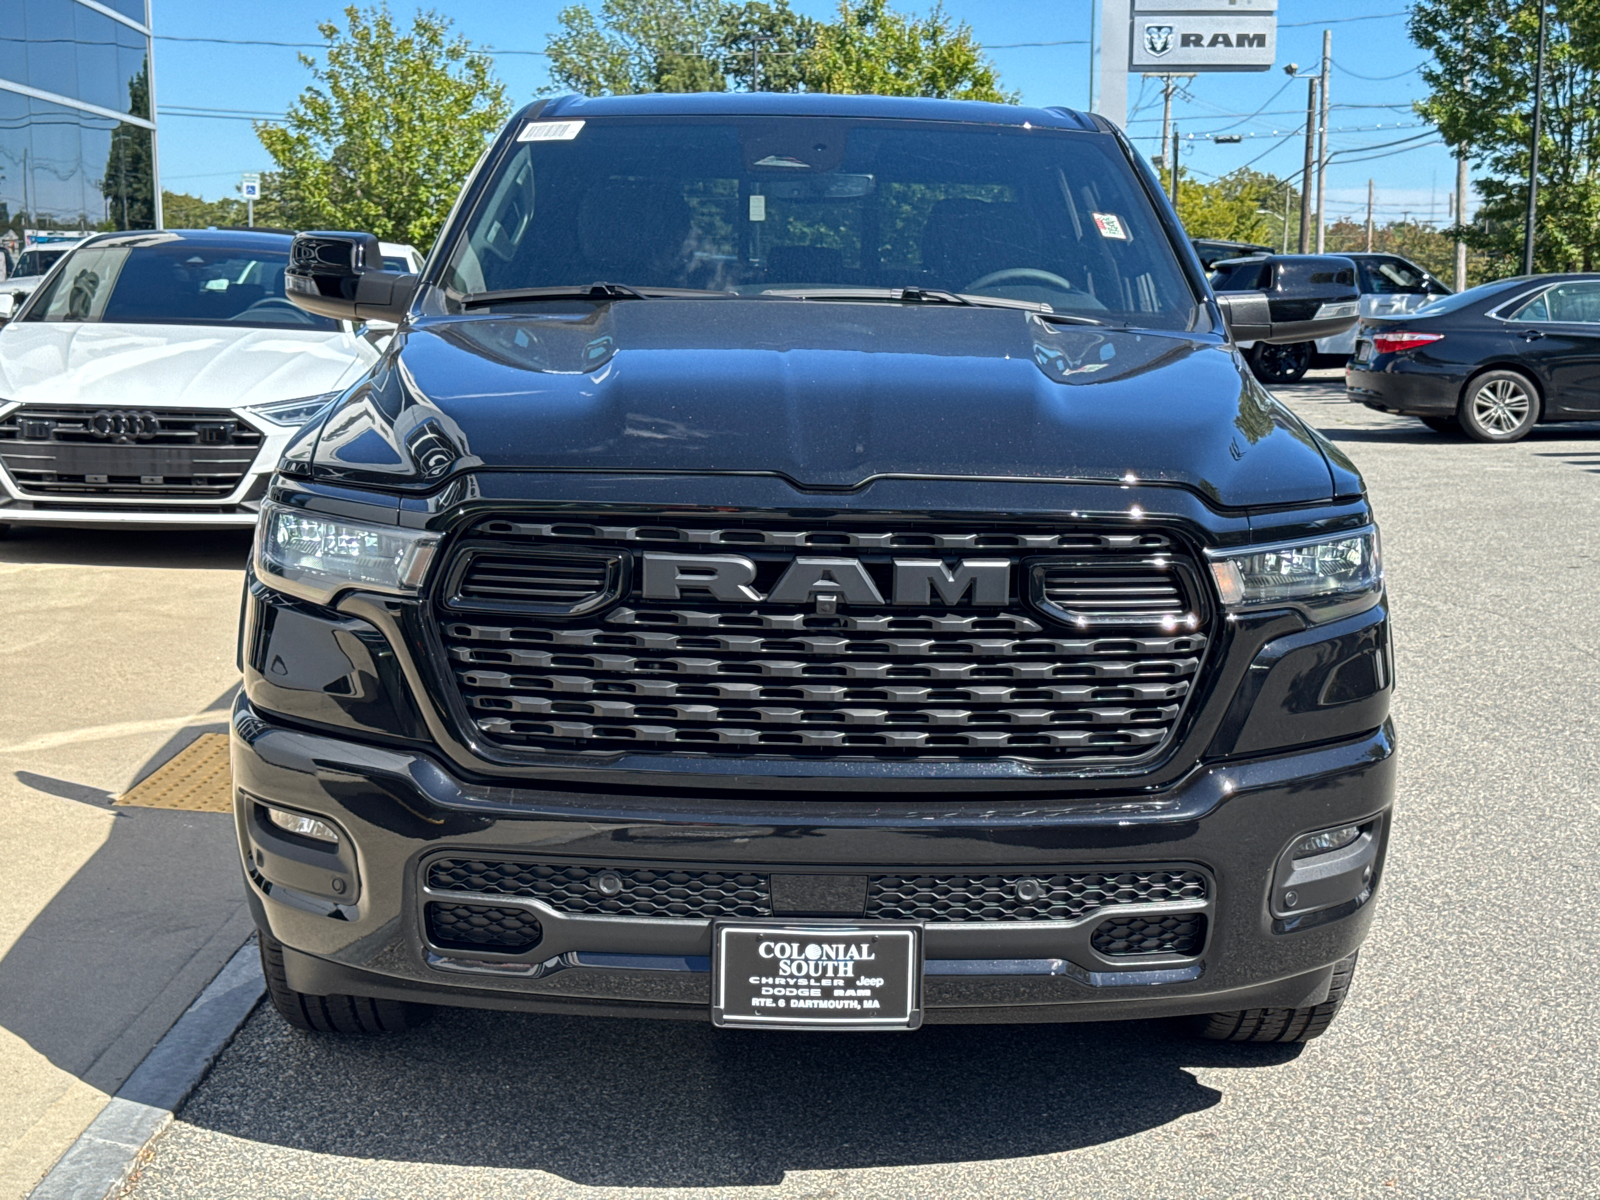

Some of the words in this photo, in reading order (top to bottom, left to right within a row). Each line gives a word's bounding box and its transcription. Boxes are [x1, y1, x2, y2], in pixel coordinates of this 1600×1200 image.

[1180, 33, 1266, 48] RAM
[642, 551, 1011, 606] RAM
[758, 941, 875, 960] COLONIAL
[779, 960, 854, 977] SOUTH
[749, 976, 845, 986] CHRYSLER
[856, 976, 884, 987] Jeep
[761, 987, 821, 997] DODGE
[834, 989, 871, 997] RAM
[752, 998, 776, 1007] RTE.
[778, 999, 786, 1007] 6
[790, 999, 861, 1009] DARTMOUTH,
[863, 1000, 880, 1009] MA
